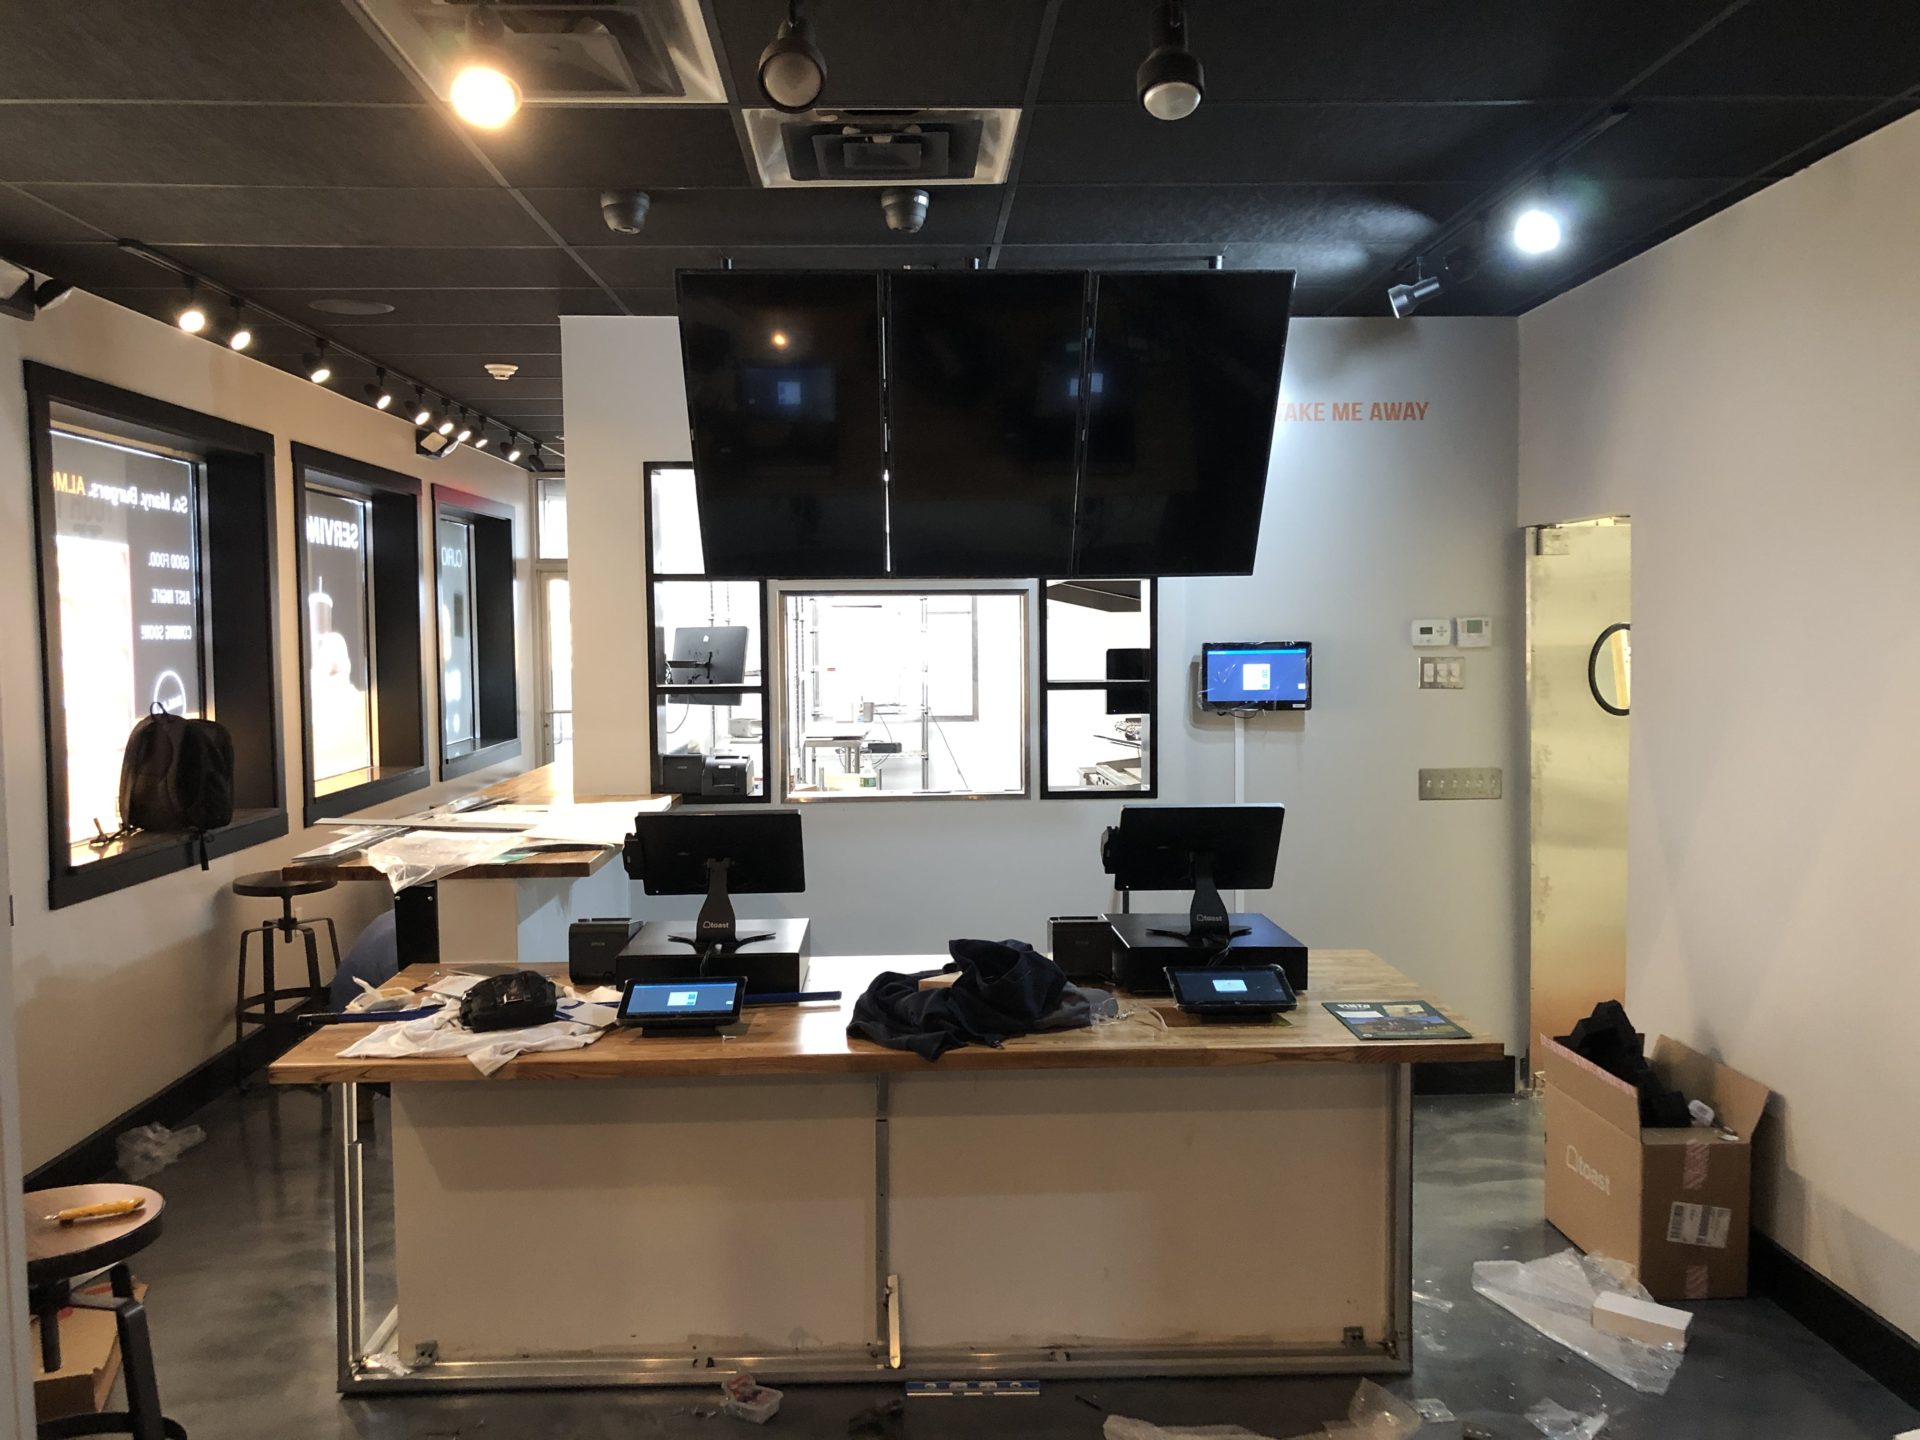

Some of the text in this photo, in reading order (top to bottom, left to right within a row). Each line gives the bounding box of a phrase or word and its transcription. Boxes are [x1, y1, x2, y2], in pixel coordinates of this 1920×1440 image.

[1332, 402, 1363, 421] ME
[1369, 402, 1429, 421] AWAY
[1577, 1156, 1611, 1196] toast
